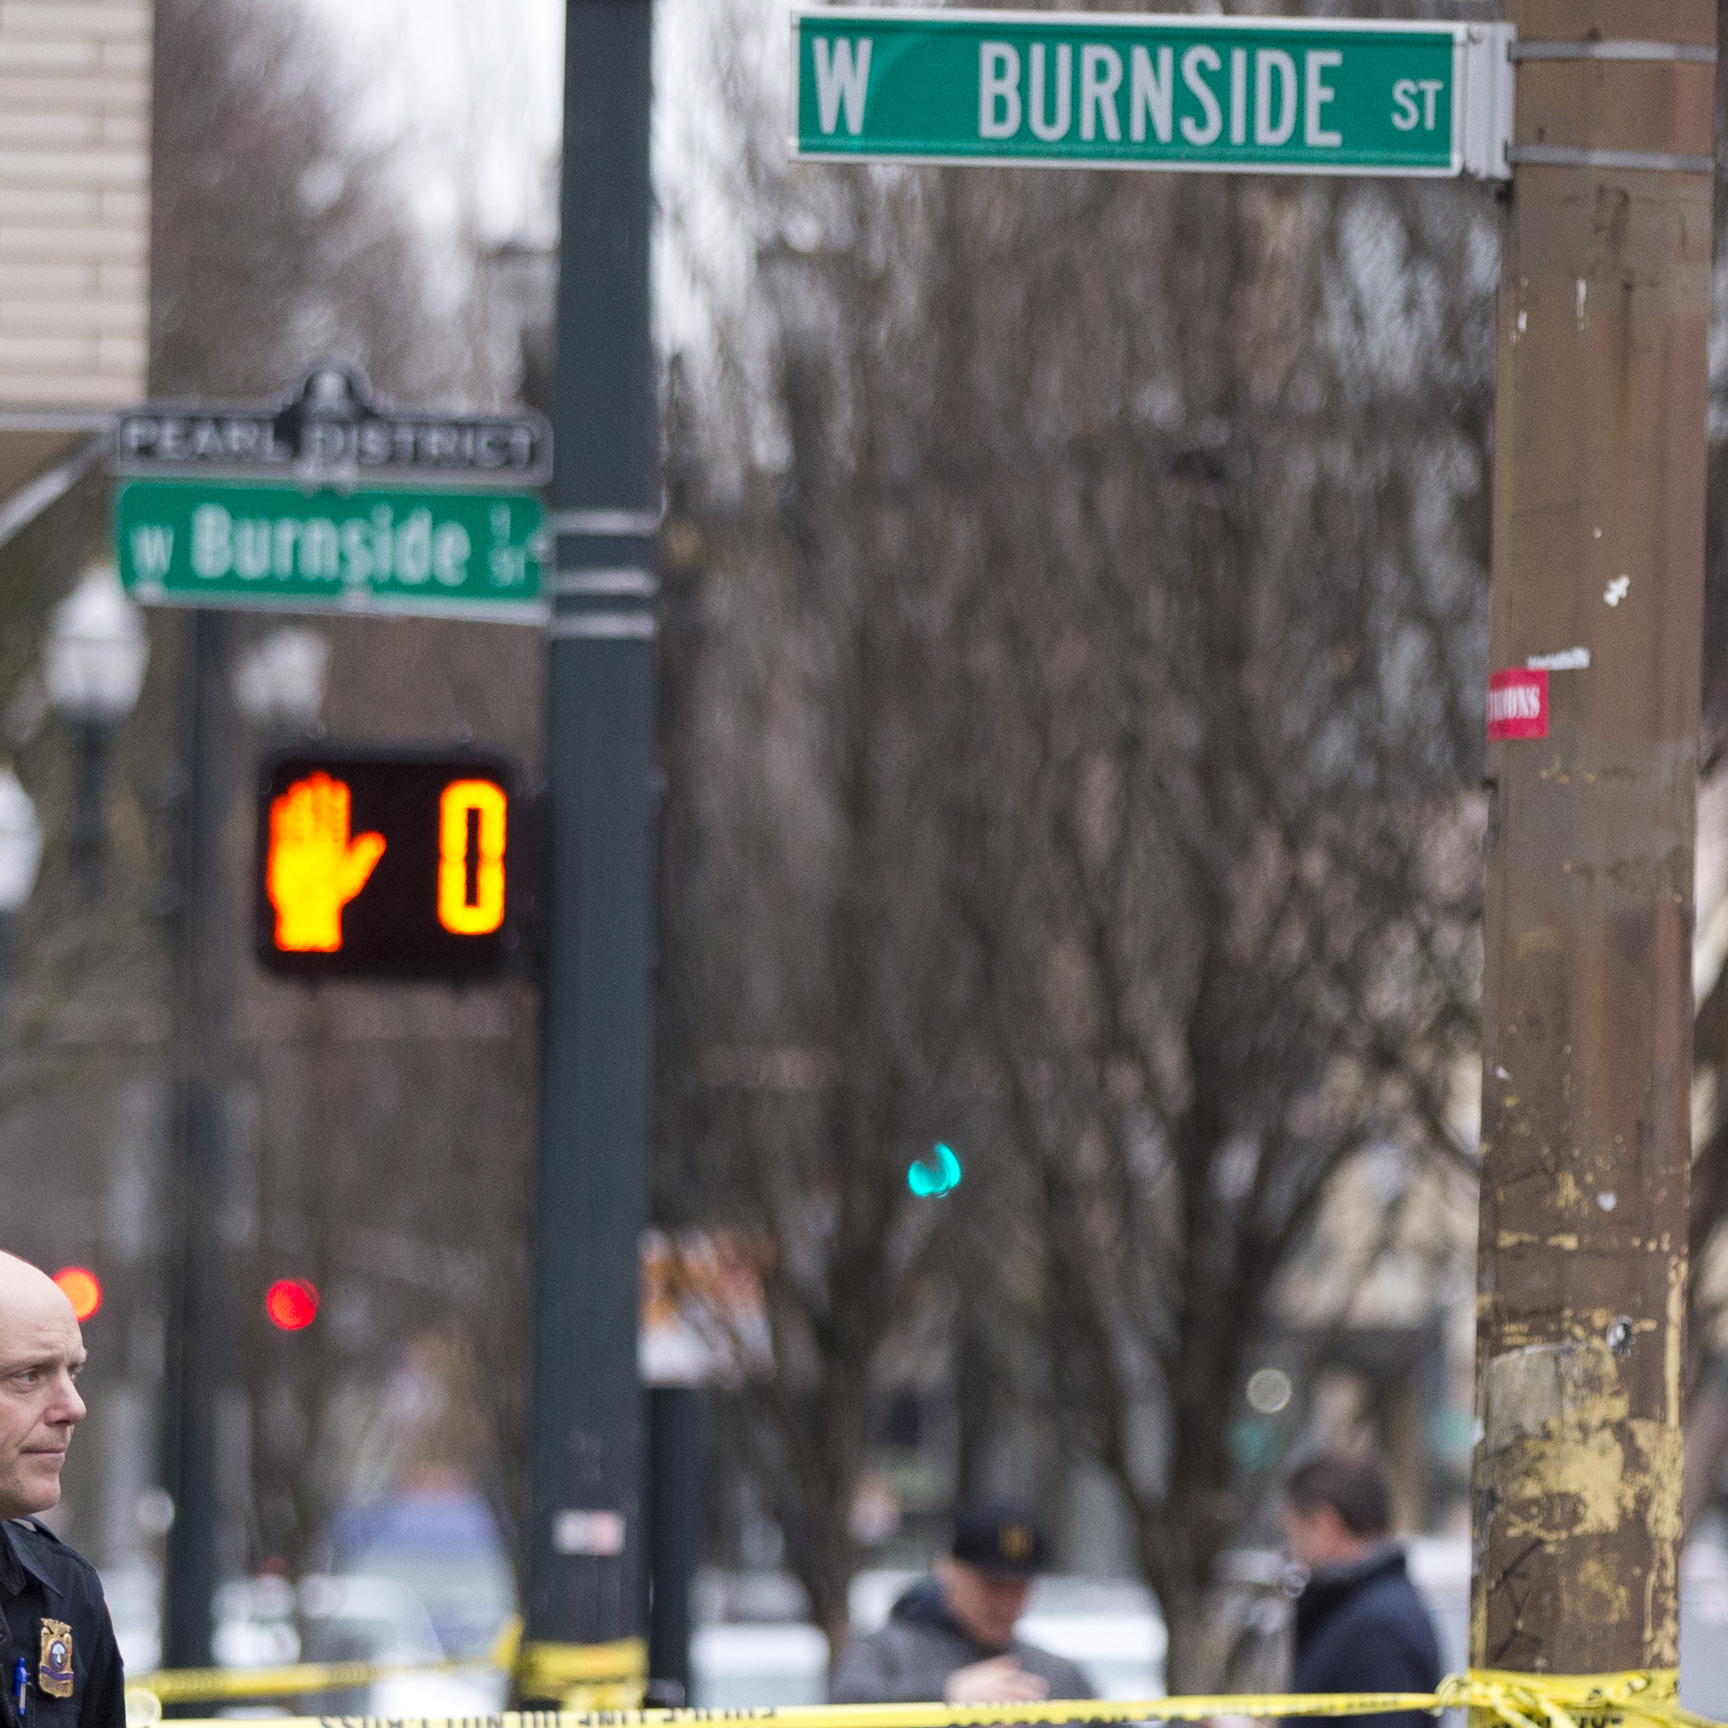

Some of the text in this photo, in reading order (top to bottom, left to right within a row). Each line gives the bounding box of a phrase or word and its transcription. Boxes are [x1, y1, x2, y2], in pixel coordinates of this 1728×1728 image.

[812, 37, 1444, 148] W BURNSIDE ST
[126, 416, 533, 468] PEARL DISTRICT
[190, 501, 472, 587] Burnside
[437, 778, 507, 936] 0
